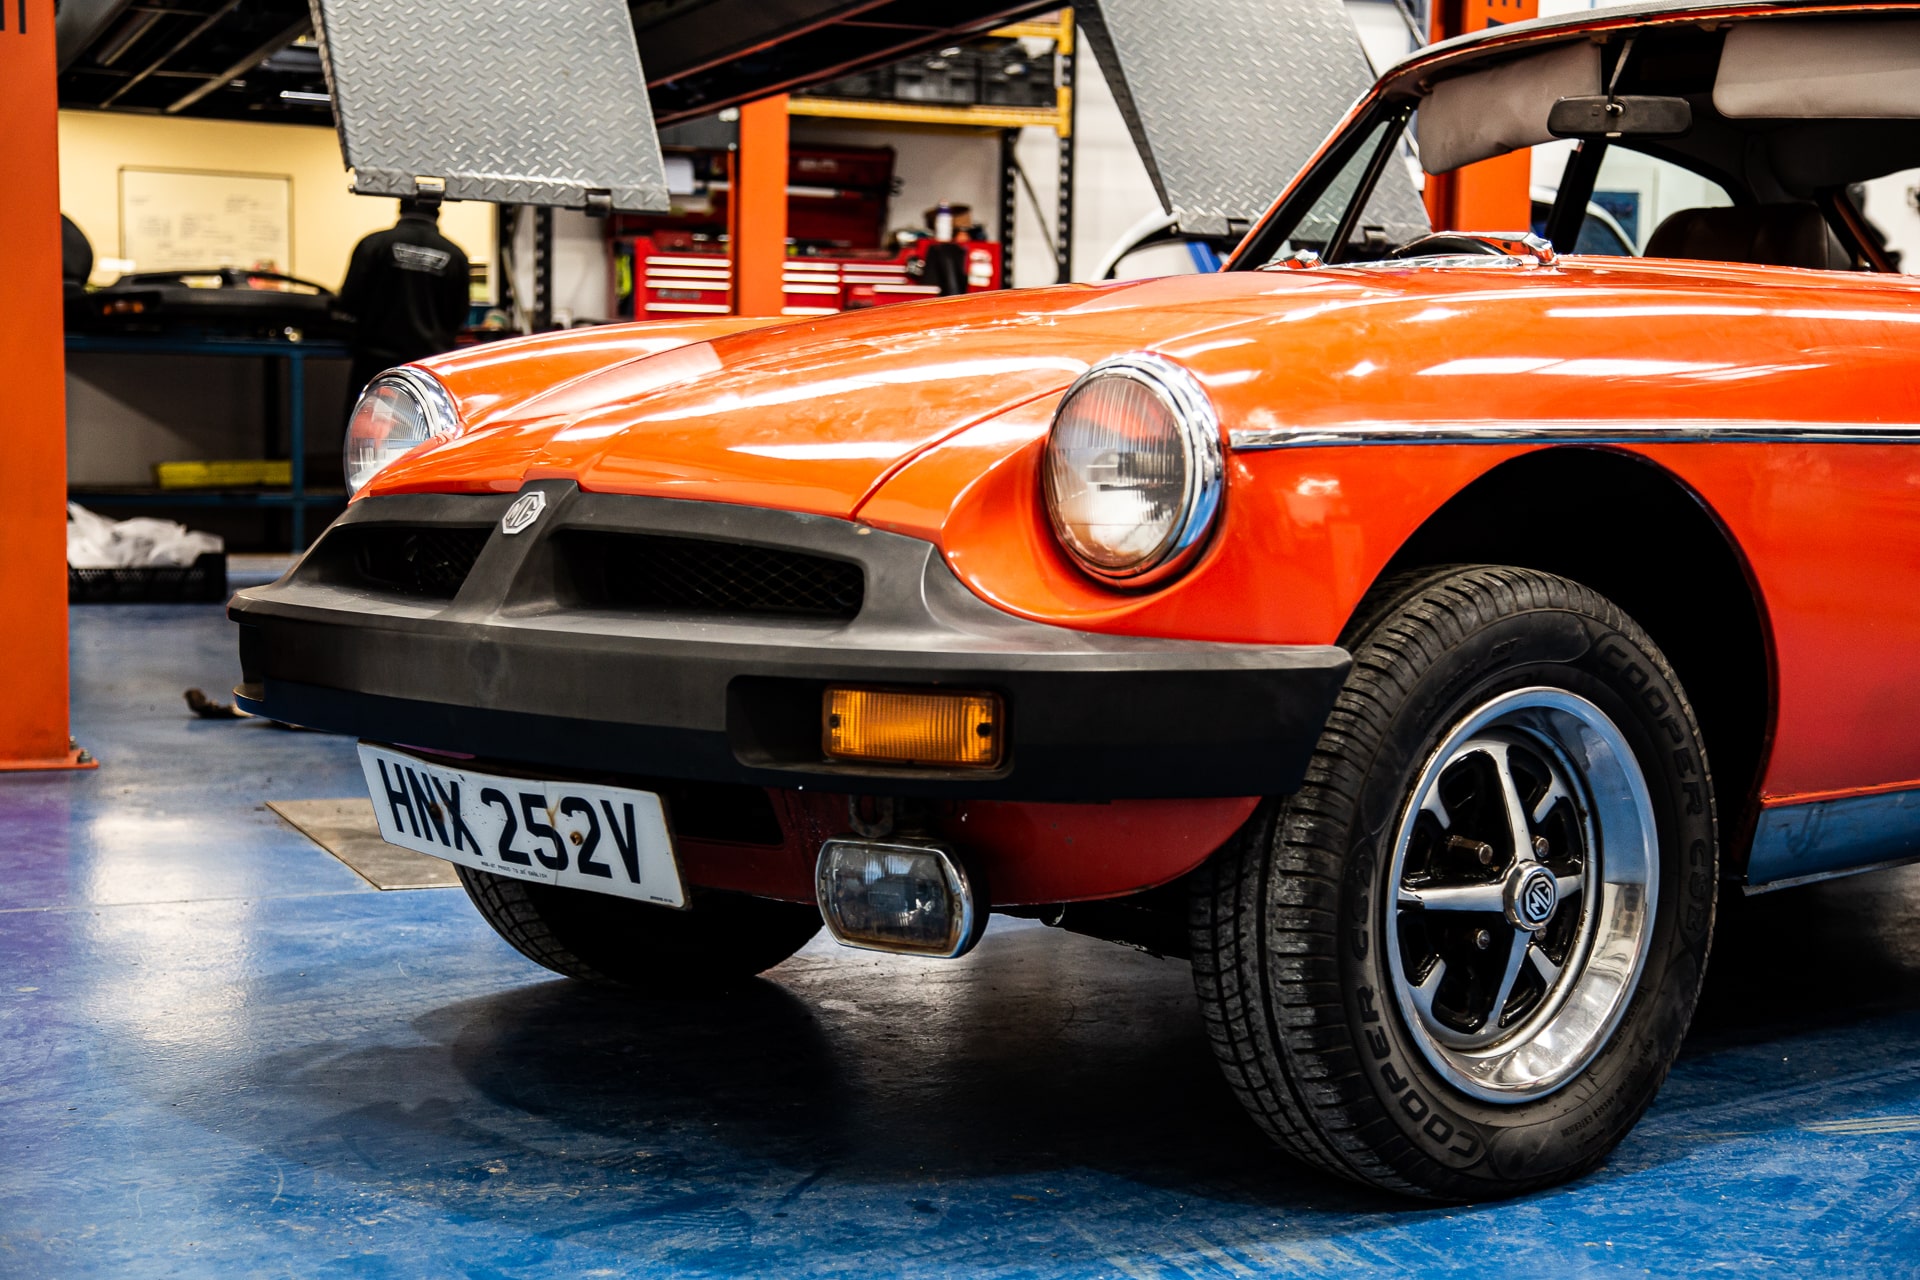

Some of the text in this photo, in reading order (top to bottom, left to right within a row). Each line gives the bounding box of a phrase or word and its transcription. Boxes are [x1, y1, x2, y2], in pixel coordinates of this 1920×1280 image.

[505, 494, 540, 529] MG
[1599, 643, 1704, 816] COOPER
[376, 758, 642, 885] HNX 252V
[1529, 882, 1551, 915] MG
[1356, 985, 1480, 1159] COOPER
